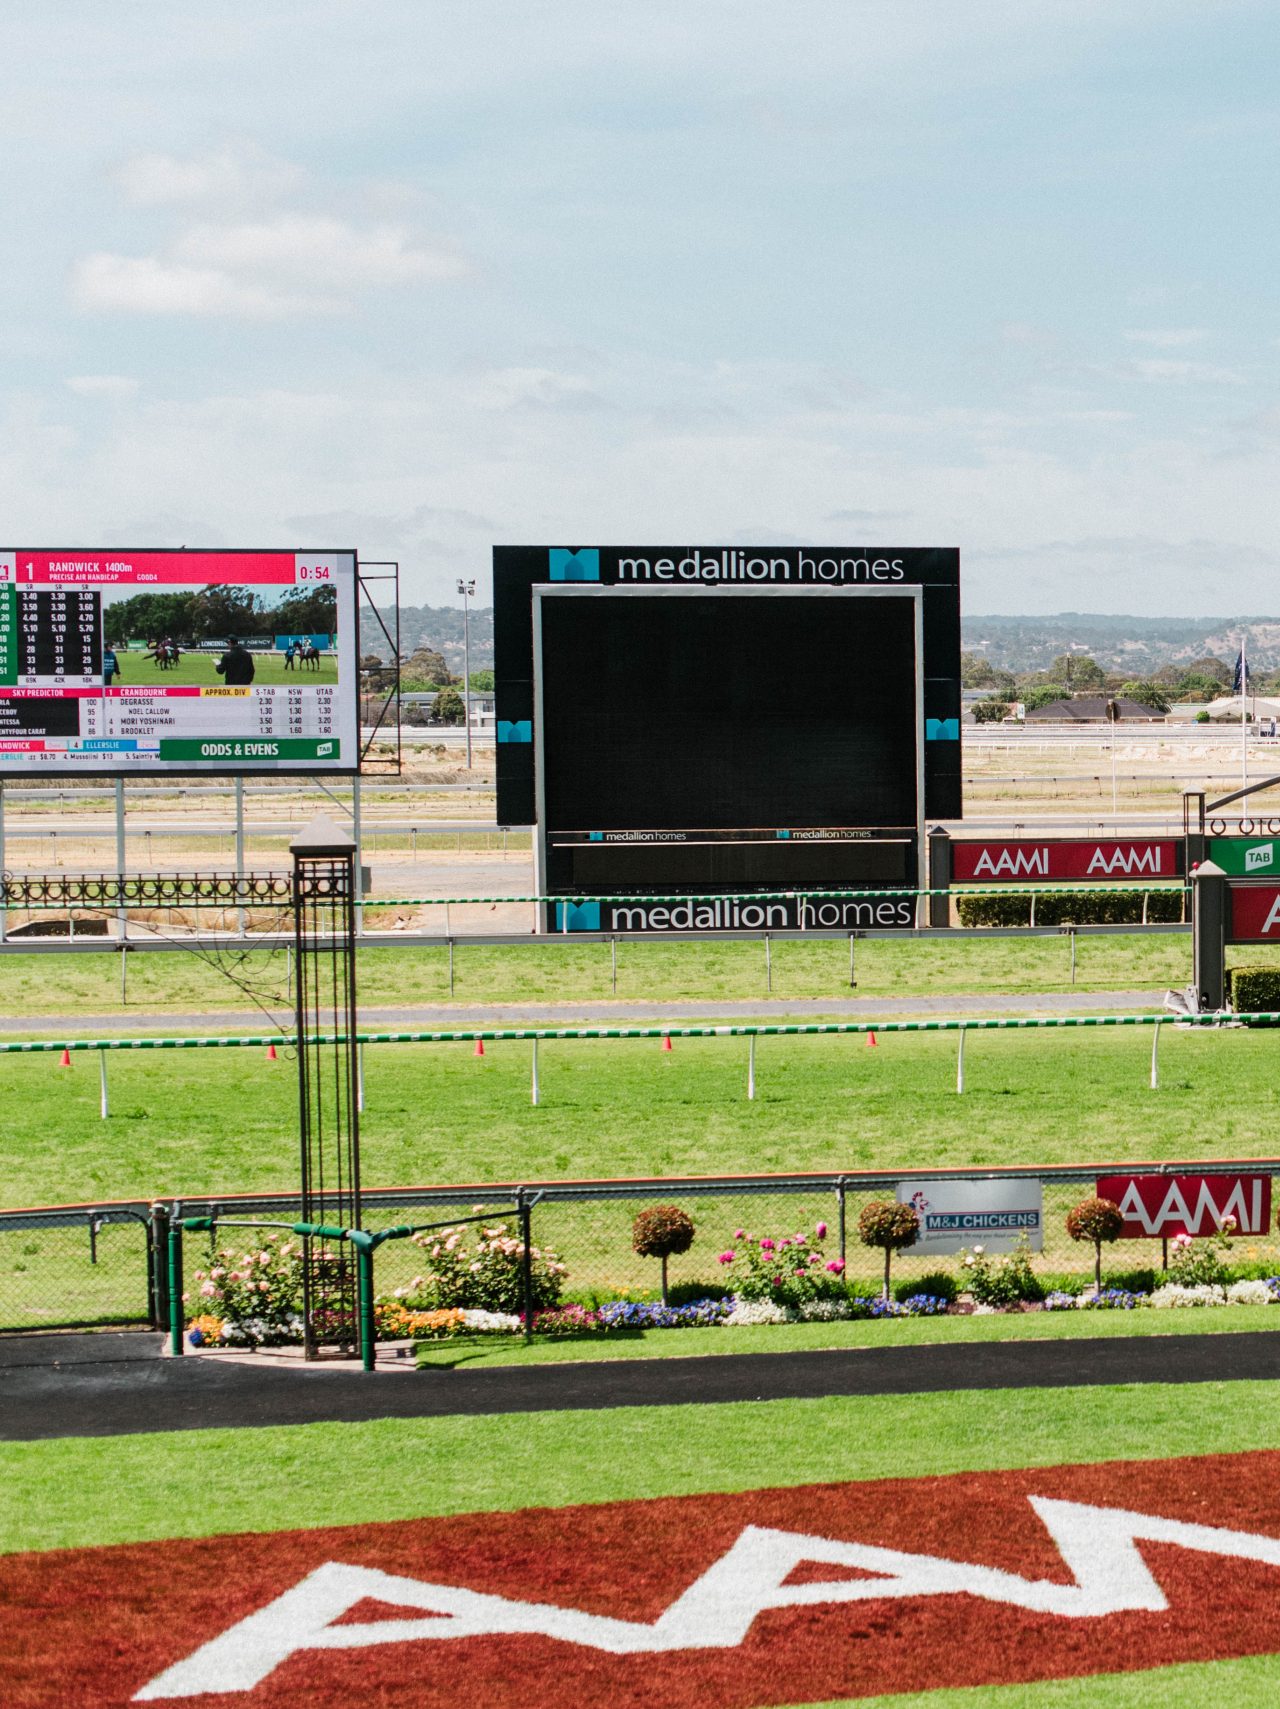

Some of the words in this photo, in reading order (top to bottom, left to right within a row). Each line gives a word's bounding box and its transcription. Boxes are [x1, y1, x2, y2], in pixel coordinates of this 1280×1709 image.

[26, 562, 34, 580] 1
[49, 562, 100, 572] RANDWICK
[105, 562, 133, 573] 1400m
[618, 551, 790, 580] medallion
[798, 551, 905, 580] homes
[300, 566, 330, 579] 0:54
[55, 645, 64, 653] 31
[82, 645, 91, 653] 31
[13, 689, 26, 697] SKY
[27, 689, 64, 697] PREDICTOR
[316, 688, 334, 696] UTAB
[120, 698, 154, 706] DEGRASSE
[86, 741, 120, 749] ELLERSLIE
[201, 743, 232, 756] ODDS
[234, 743, 243, 756] &
[245, 743, 279, 756] EVENS
[606, 832, 655, 841] medallion
[655, 832, 687, 841] homes
[793, 830, 841, 839] medallion
[841, 829, 872, 838] homes
[973, 847, 1049, 876] AAMI
[1086, 846, 1161, 874] AAMI
[1248, 852, 1271, 863] TAB
[612, 898, 787, 930] medallion
[798, 897, 911, 927] homes
[1119, 1179, 1263, 1235] AAMI
[928, 1216, 960, 1229] M&J
[963, 1213, 1037, 1227] CHICKENS
